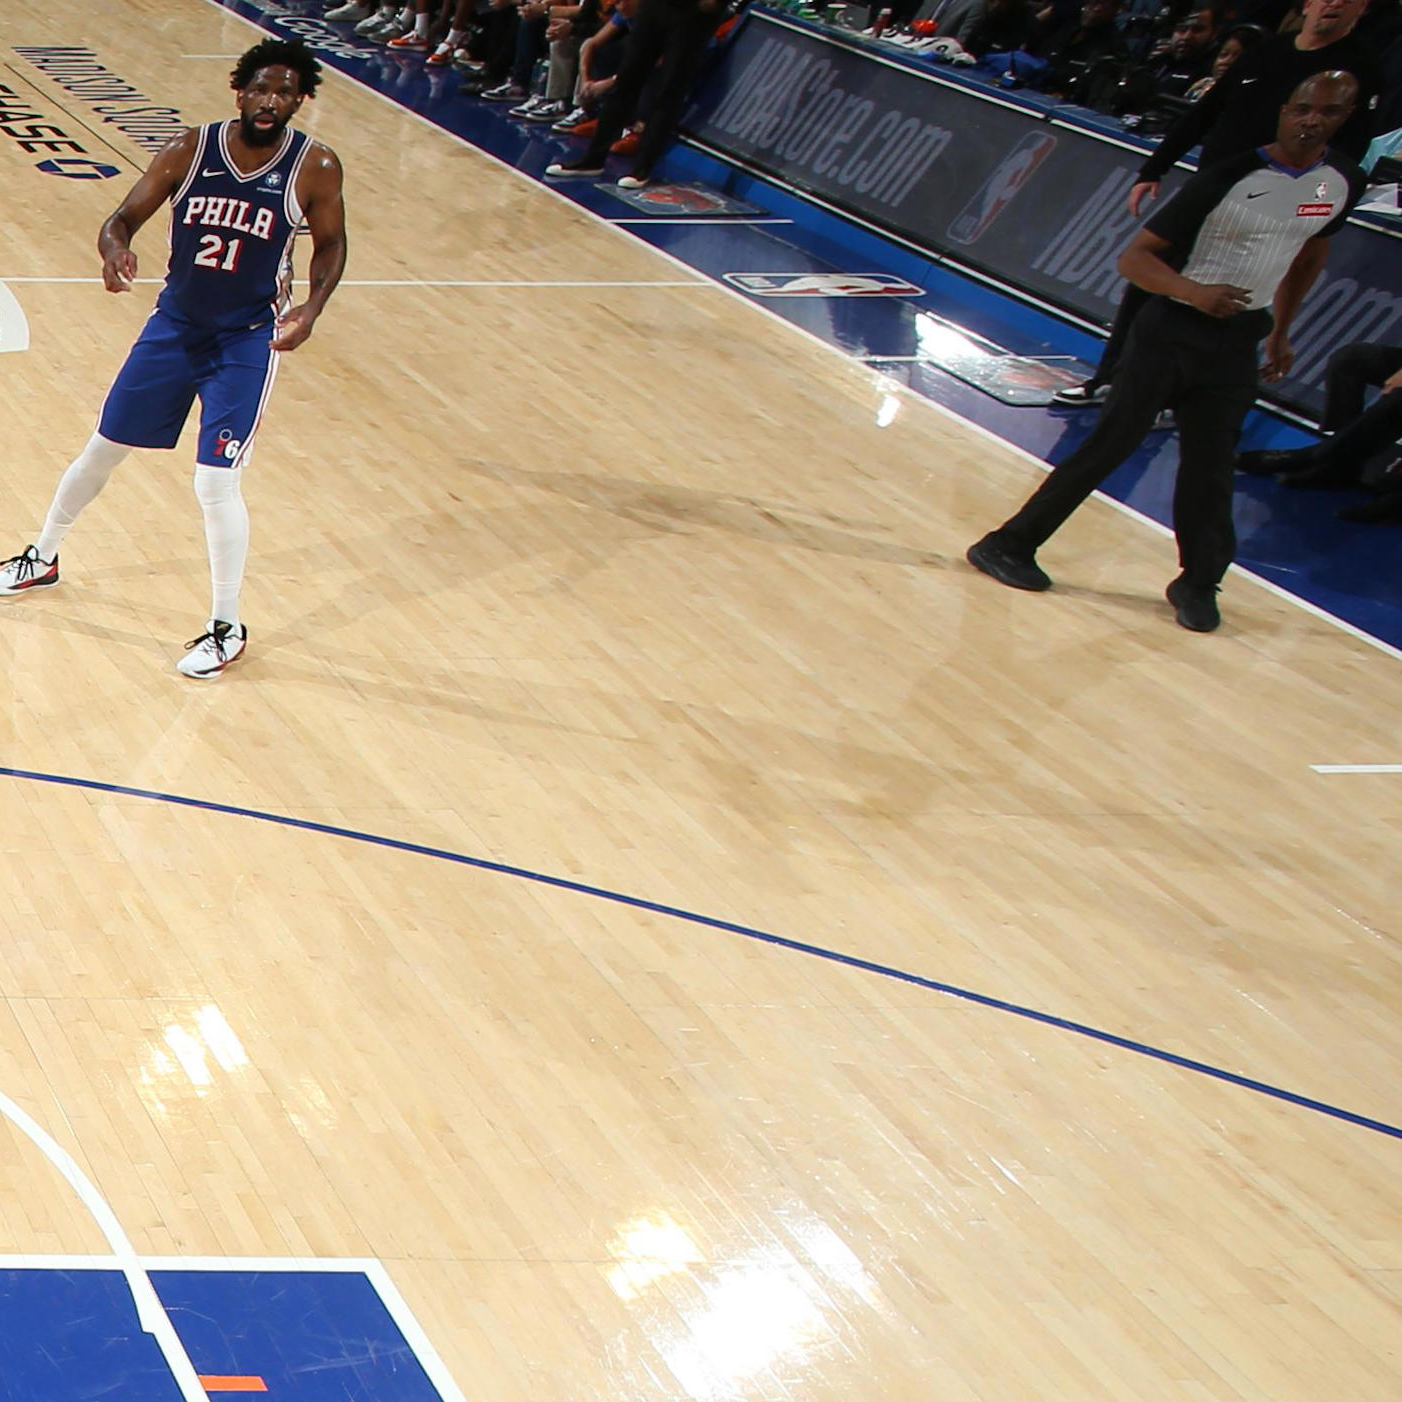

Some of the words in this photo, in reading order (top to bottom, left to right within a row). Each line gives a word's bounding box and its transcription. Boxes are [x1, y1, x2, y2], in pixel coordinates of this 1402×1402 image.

[11, 46, 152, 102] MADISON
[707, 37, 953, 207] NBAStore.com
[182, 196, 275, 241] PHILA
[194, 233, 241, 275] 21
